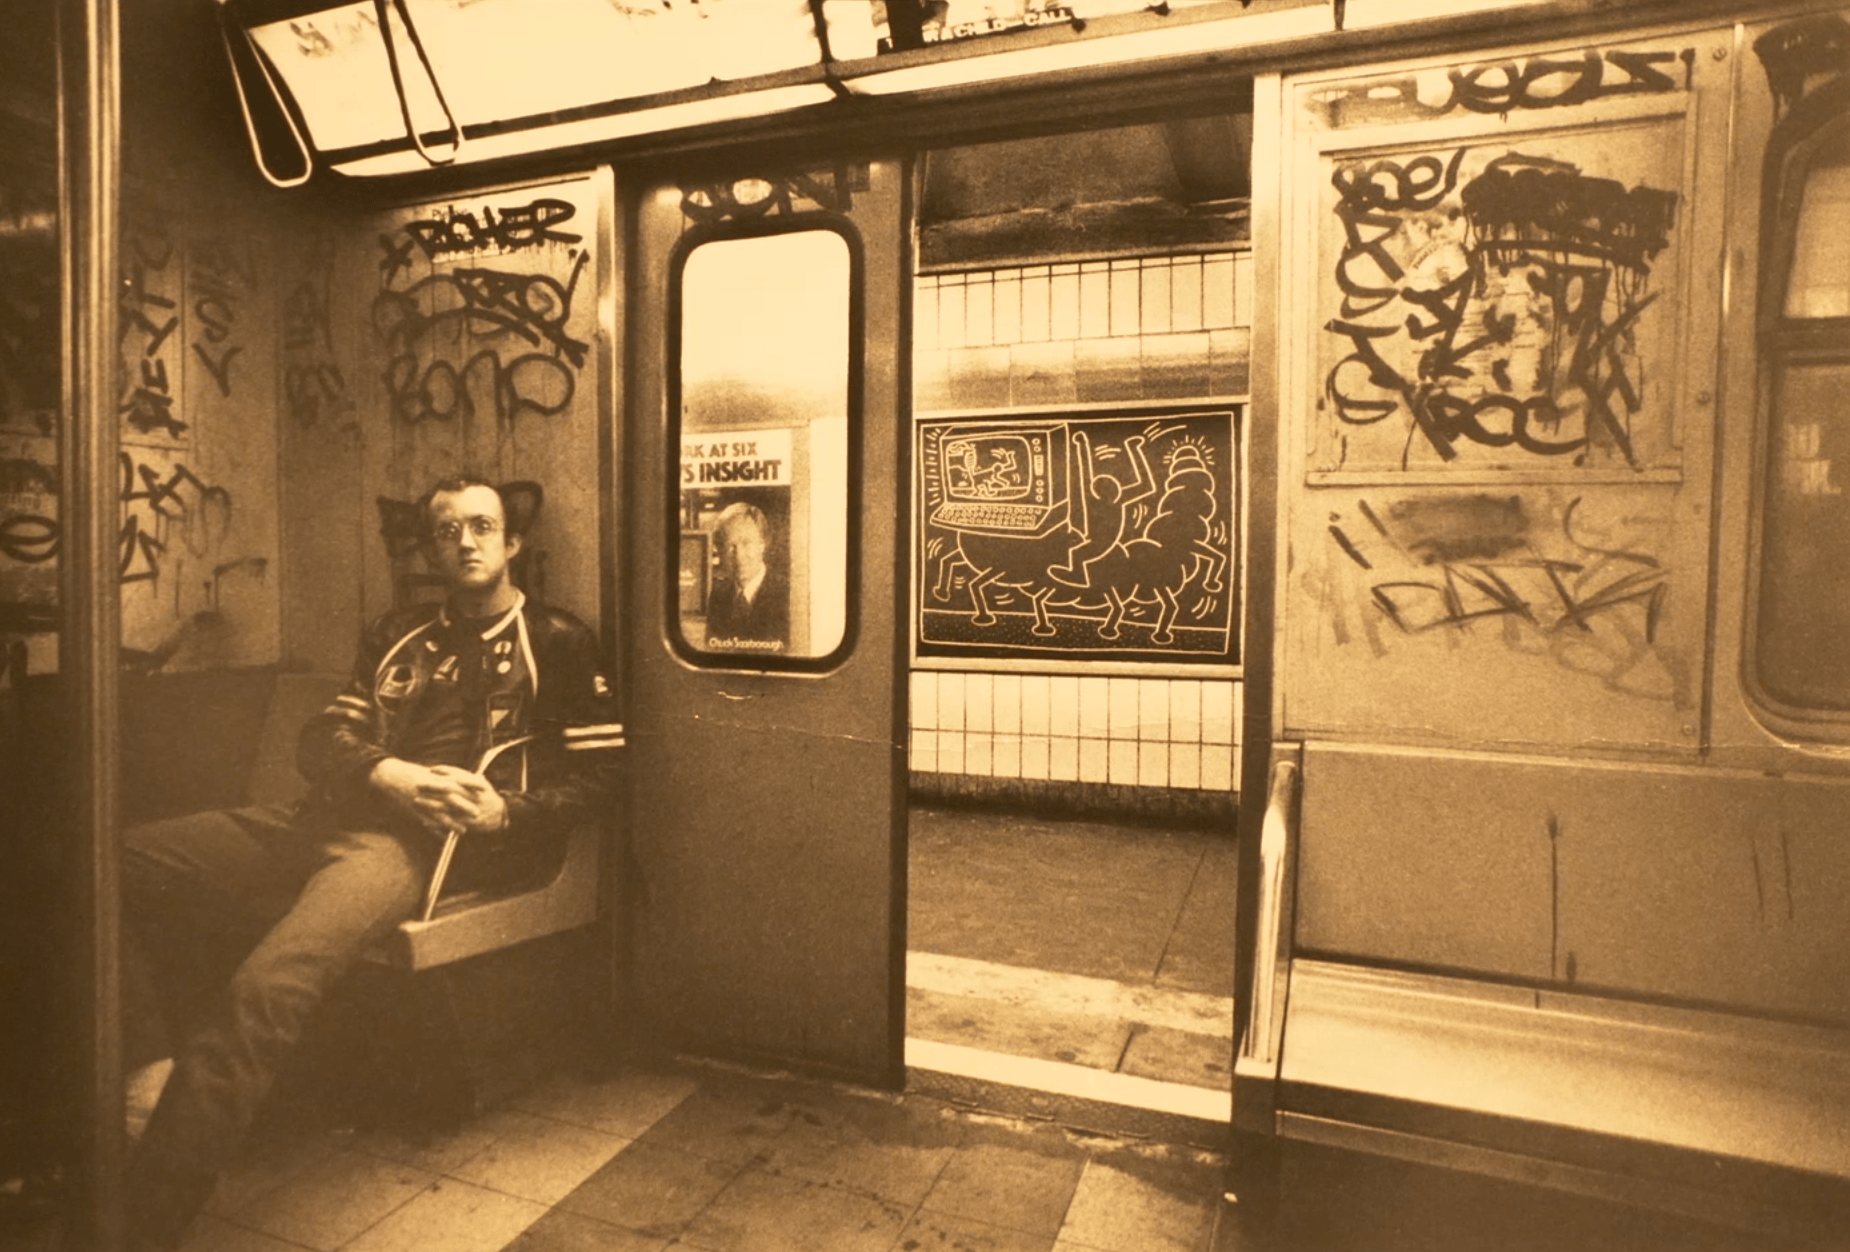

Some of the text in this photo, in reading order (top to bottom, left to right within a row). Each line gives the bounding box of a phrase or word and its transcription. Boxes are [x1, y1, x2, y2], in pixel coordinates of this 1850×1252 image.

[709, 443, 728, 457] AT
[732, 442, 758, 457] SIX
[699, 460, 782, 483] INSIGHT
